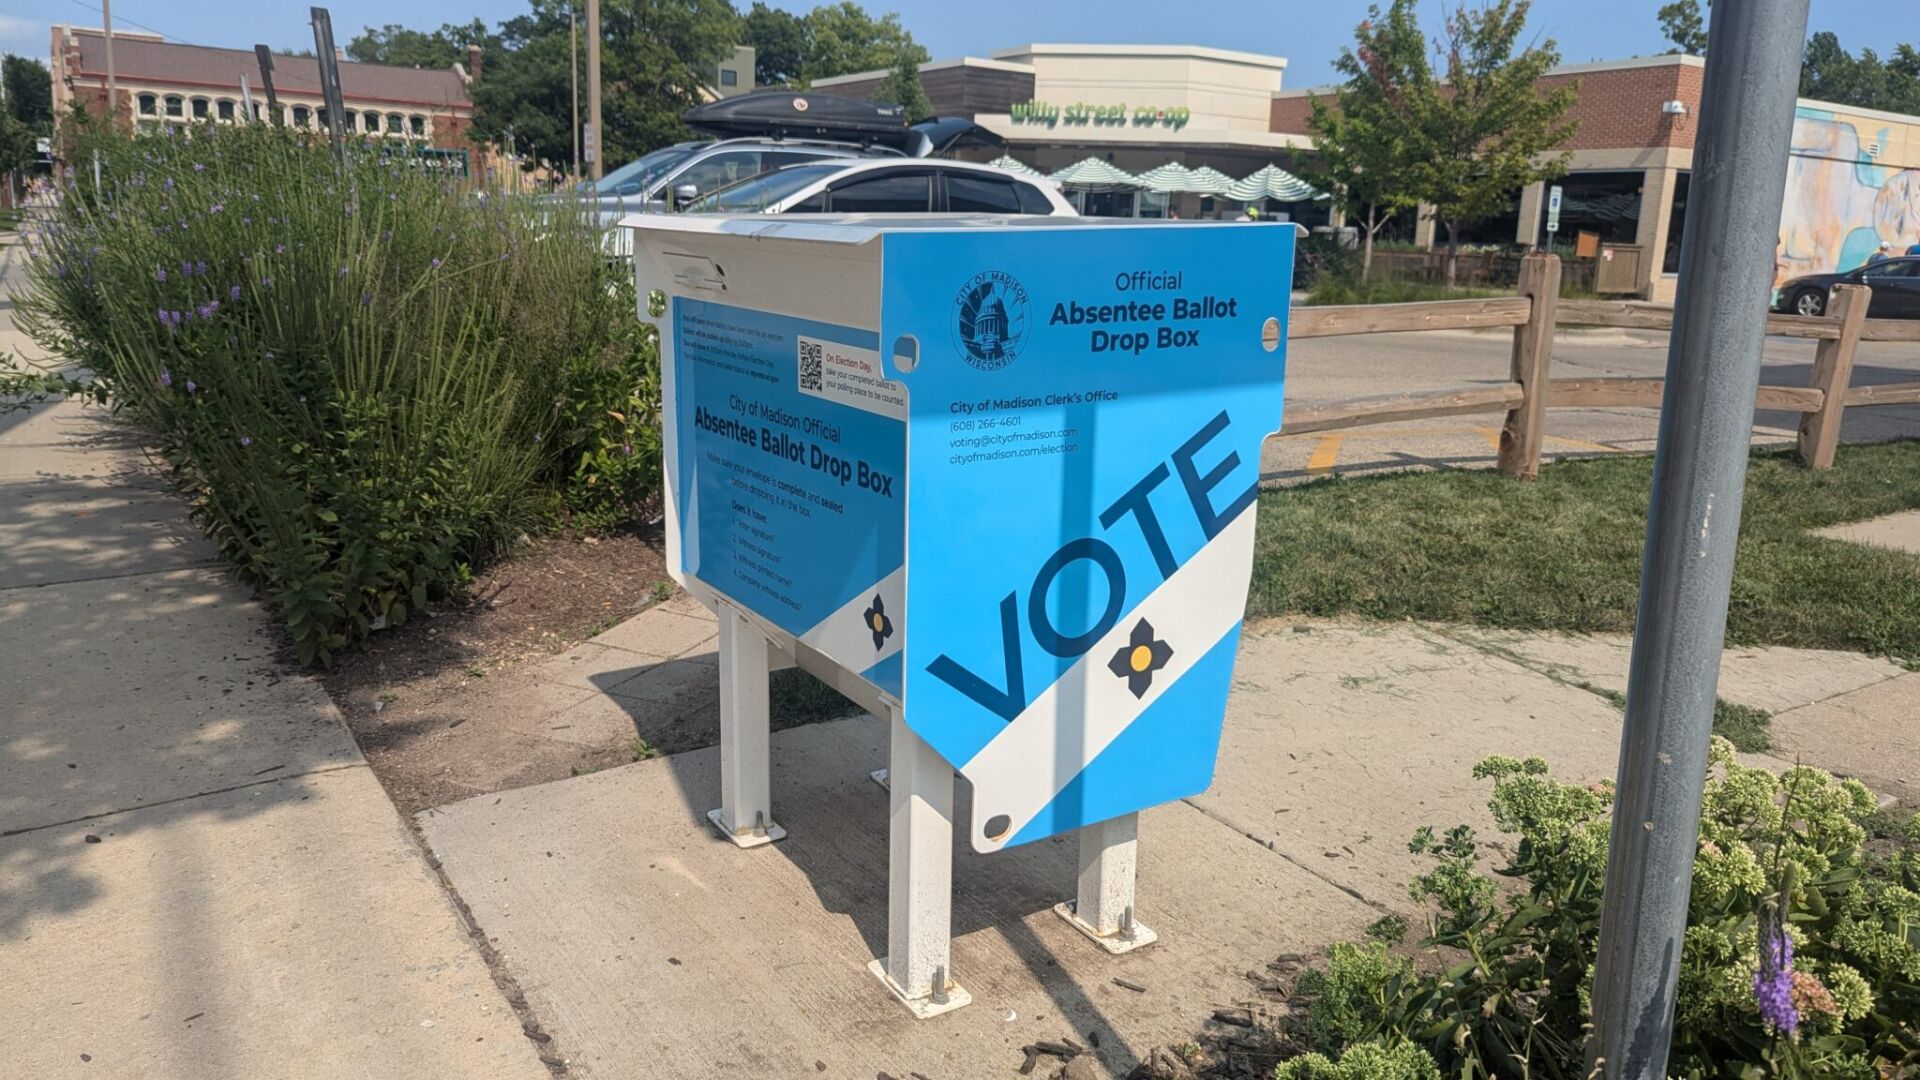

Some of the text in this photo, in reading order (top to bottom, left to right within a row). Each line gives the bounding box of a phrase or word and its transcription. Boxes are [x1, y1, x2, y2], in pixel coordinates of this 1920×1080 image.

[1009, 98, 1060, 130] willy
[1063, 102, 1127, 126] street
[956, 272, 1029, 306] CITY OF MADISON
[1115, 271, 1182, 291] Official
[1049, 296, 1237, 326] Absentee Ballot
[1091, 327, 1200, 355] Drop Box
[826, 353, 834, 363] On
[836, 355, 858, 368] Election
[965, 349, 1016, 369] WISCONSIN
[826, 380, 835, 389] your
[837, 383, 853, 394] polling
[854, 386, 867, 397] place
[867, 389, 874, 397] to
[874, 391, 881, 400] be
[837, 371, 847, 380] your
[848, 373, 875, 386] completed
[876, 379, 889, 389] ballot
[890, 382, 896, 391] to
[950, 390, 1118, 415] City of Madison Clerk's Office
[729, 394, 841, 444] City of Madison Official
[950, 416, 1021, 433] (608) 266-4601
[949, 427, 1078, 448] voting@cityofmadison.com
[695, 405, 894, 498] Absentee Ballot Drop Box
[949, 443, 1078, 465] cityofmadison.com/election
[777, 479, 807, 499] complete
[925, 409, 1259, 723] VOTE
